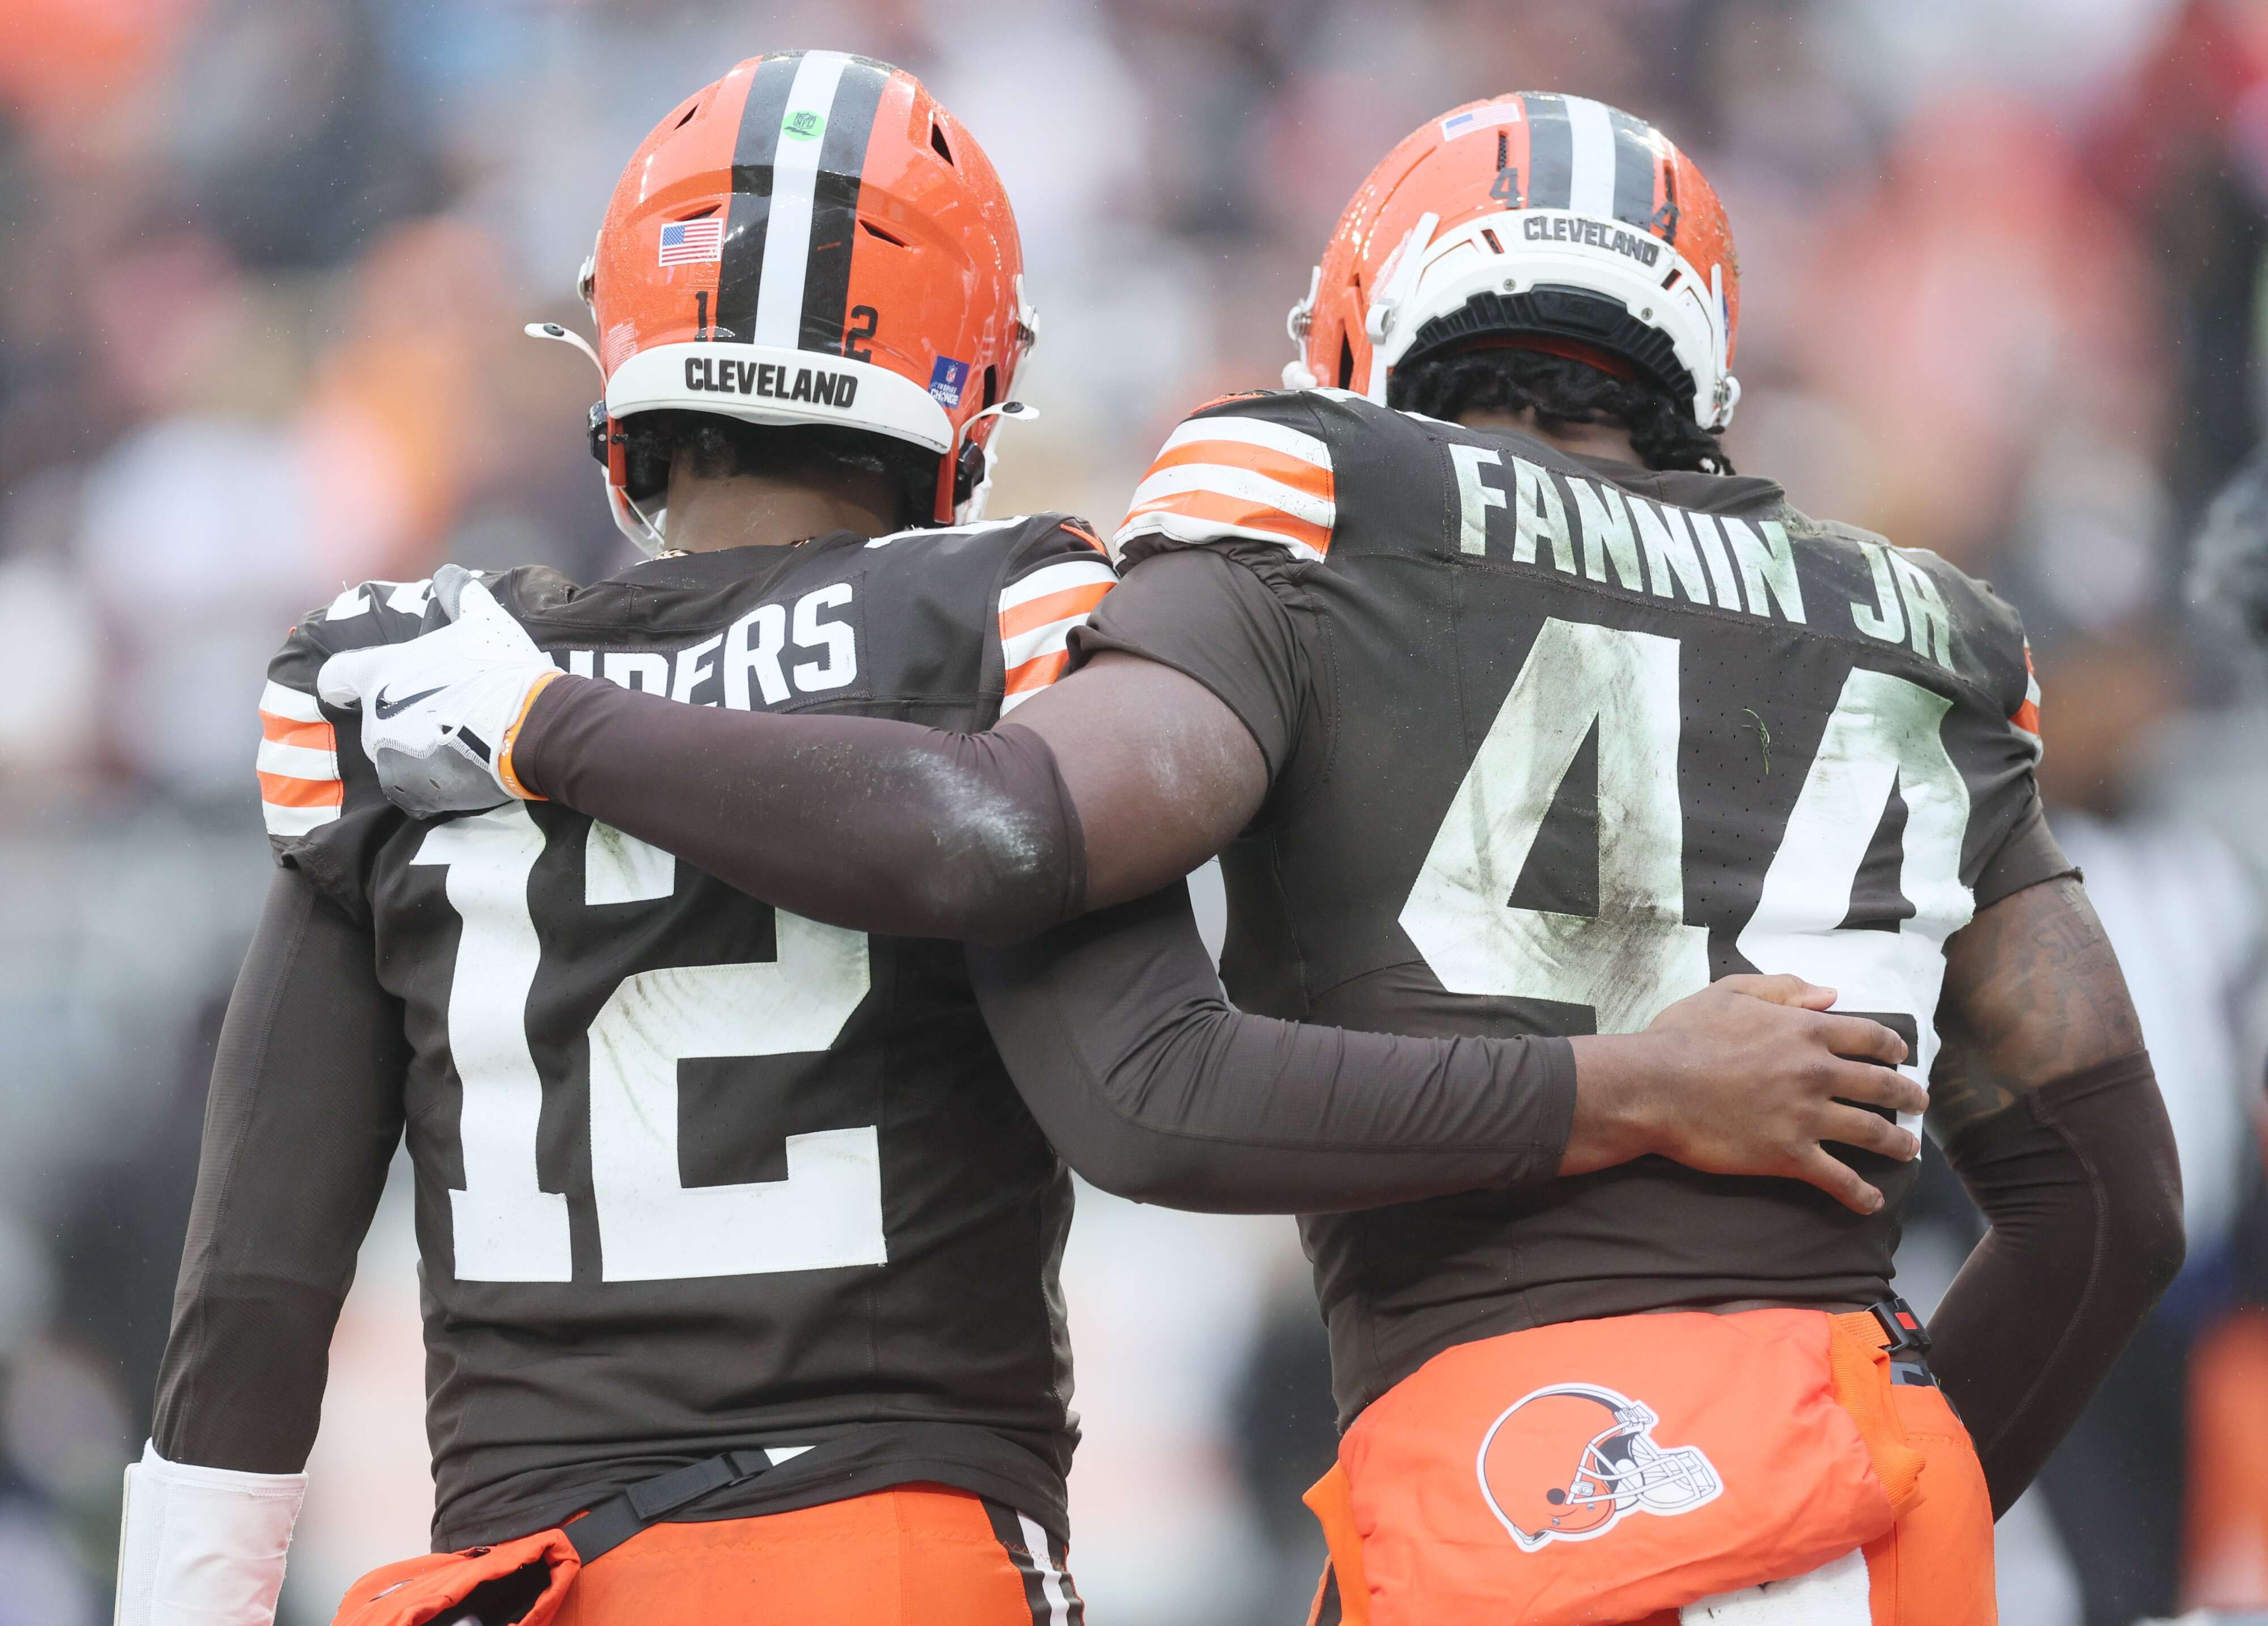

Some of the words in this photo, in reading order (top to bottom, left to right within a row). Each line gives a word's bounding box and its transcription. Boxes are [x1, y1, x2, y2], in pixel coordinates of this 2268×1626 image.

[1490, 168, 1521, 208] 4
[1523, 216, 1659, 267] CLEVELAND
[695, 291, 708, 342] 1
[844, 305, 878, 364] 2
[684, 357, 858, 408] CLEVELAND
[930, 388, 959, 405] CHANGE
[937, 383, 957, 394] INSPIRE
[1449, 443, 1806, 624] FANNIN
[1850, 541, 1956, 674] JR
[570, 583, 857, 710] DERS
[1398, 616, 1975, 1160] 44
[409, 799, 887, 1282] 12
